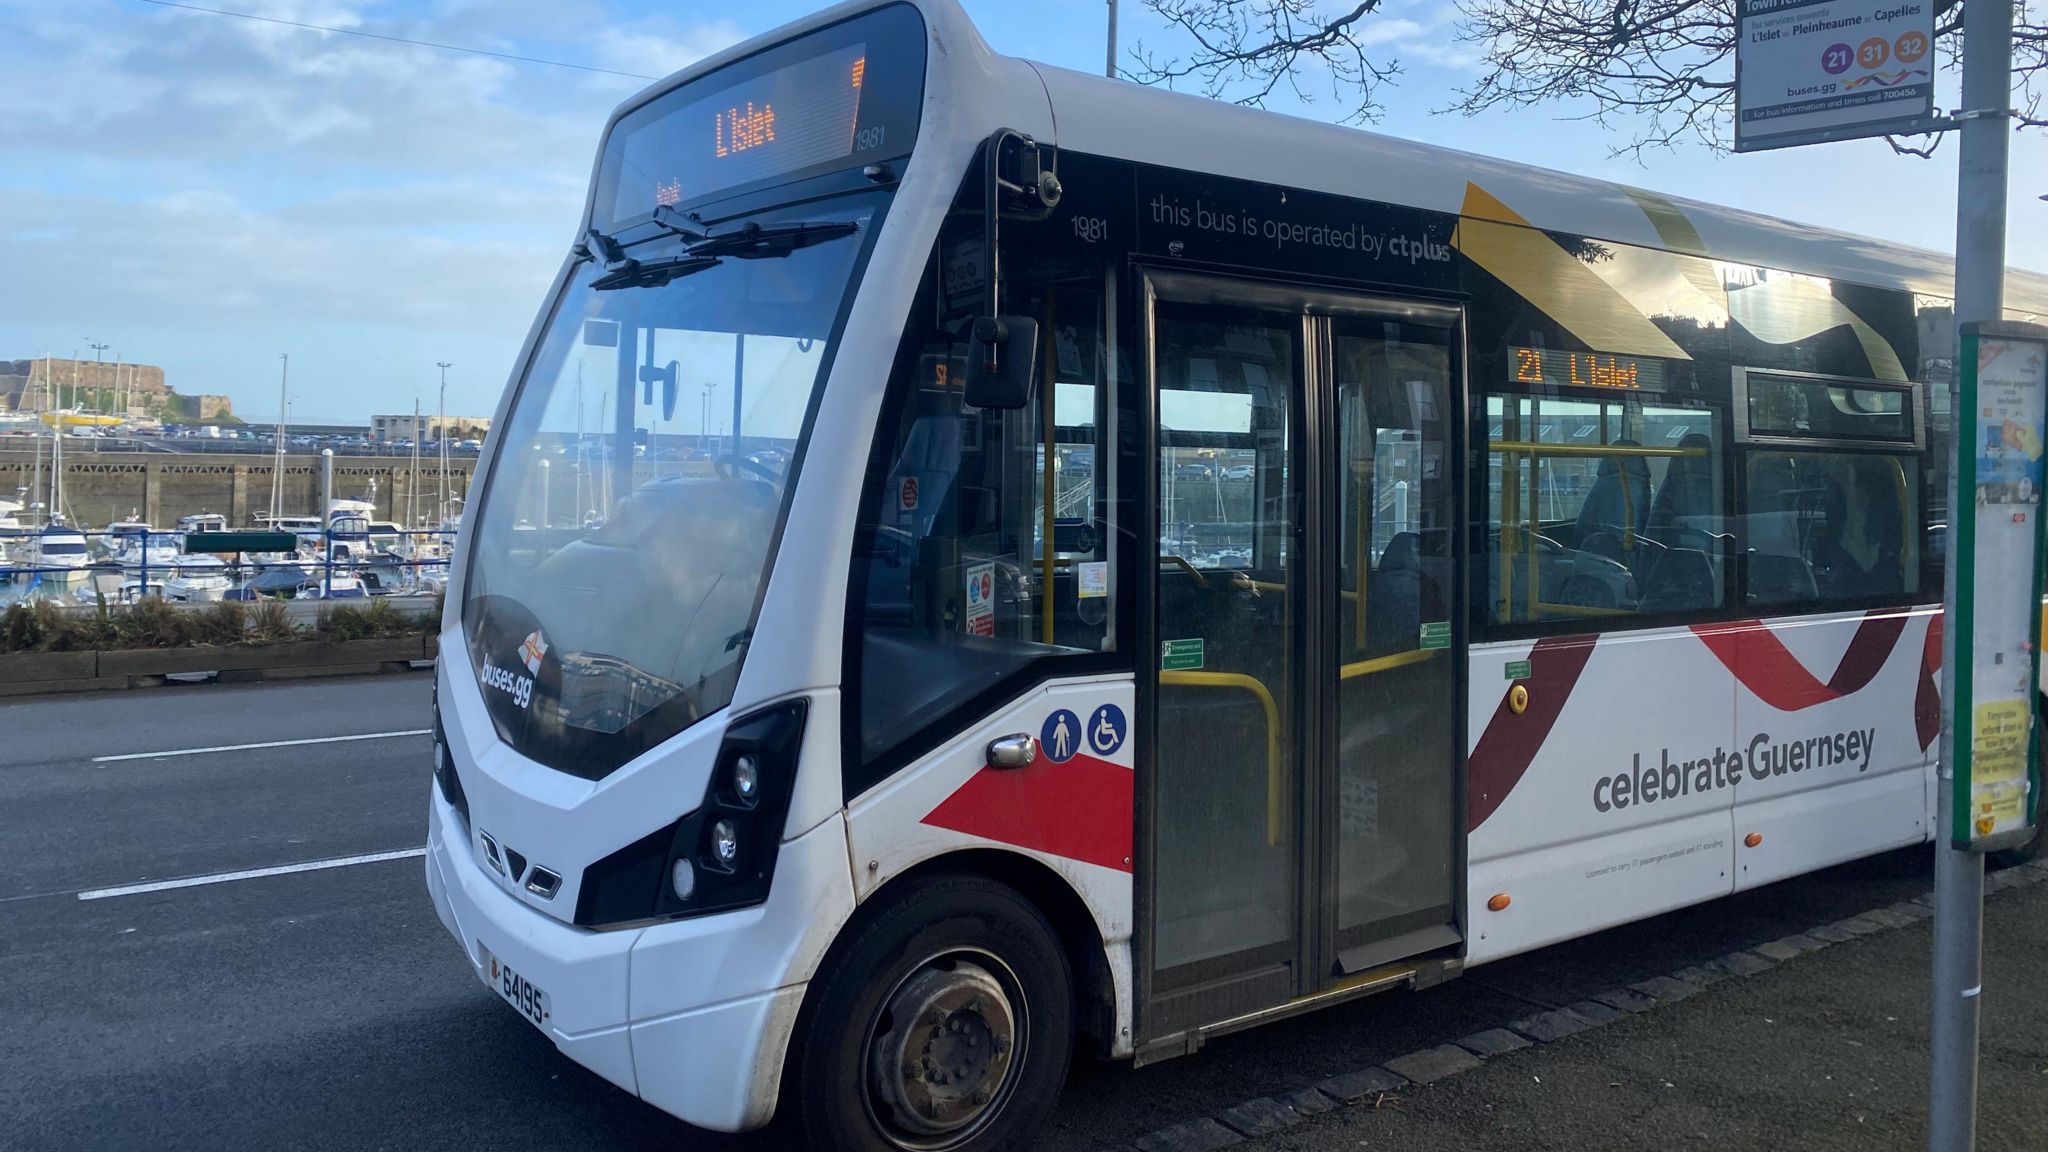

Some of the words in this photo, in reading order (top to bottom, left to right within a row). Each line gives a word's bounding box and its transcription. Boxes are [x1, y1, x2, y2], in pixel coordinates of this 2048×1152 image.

[1752, 30, 1780, 43] L'Islet
[1792, 15, 1862, 36] Pleinheaume
[1874, 5, 1920, 22] Capelles
[1764, 15, 1795, 27] services
[1828, 50, 1847, 68] 21
[1863, 44, 1883, 62] 31
[1901, 38, 1922, 56] 32
[1766, 108, 1780, 116] bus
[1781, 102, 1826, 114] information
[1882, 88, 1917, 99] 700456
[1787, 82, 1837, 97] buses.gg
[716, 102, 775, 157] L'Islet
[856, 124, 885, 151] 1981
[1070, 215, 1107, 241] 1981
[1150, 194, 1191, 227] this
[1197, 200, 1236, 233] bus
[1242, 208, 1258, 236] is
[1263, 220, 1356, 250] operated
[1361, 224, 1384, 260] by
[1517, 349, 1543, 381] 21
[1570, 353, 1640, 388] L'Islet
[481, 652, 533, 709] buses.gg
[503, 965, 543, 1024] 64195
